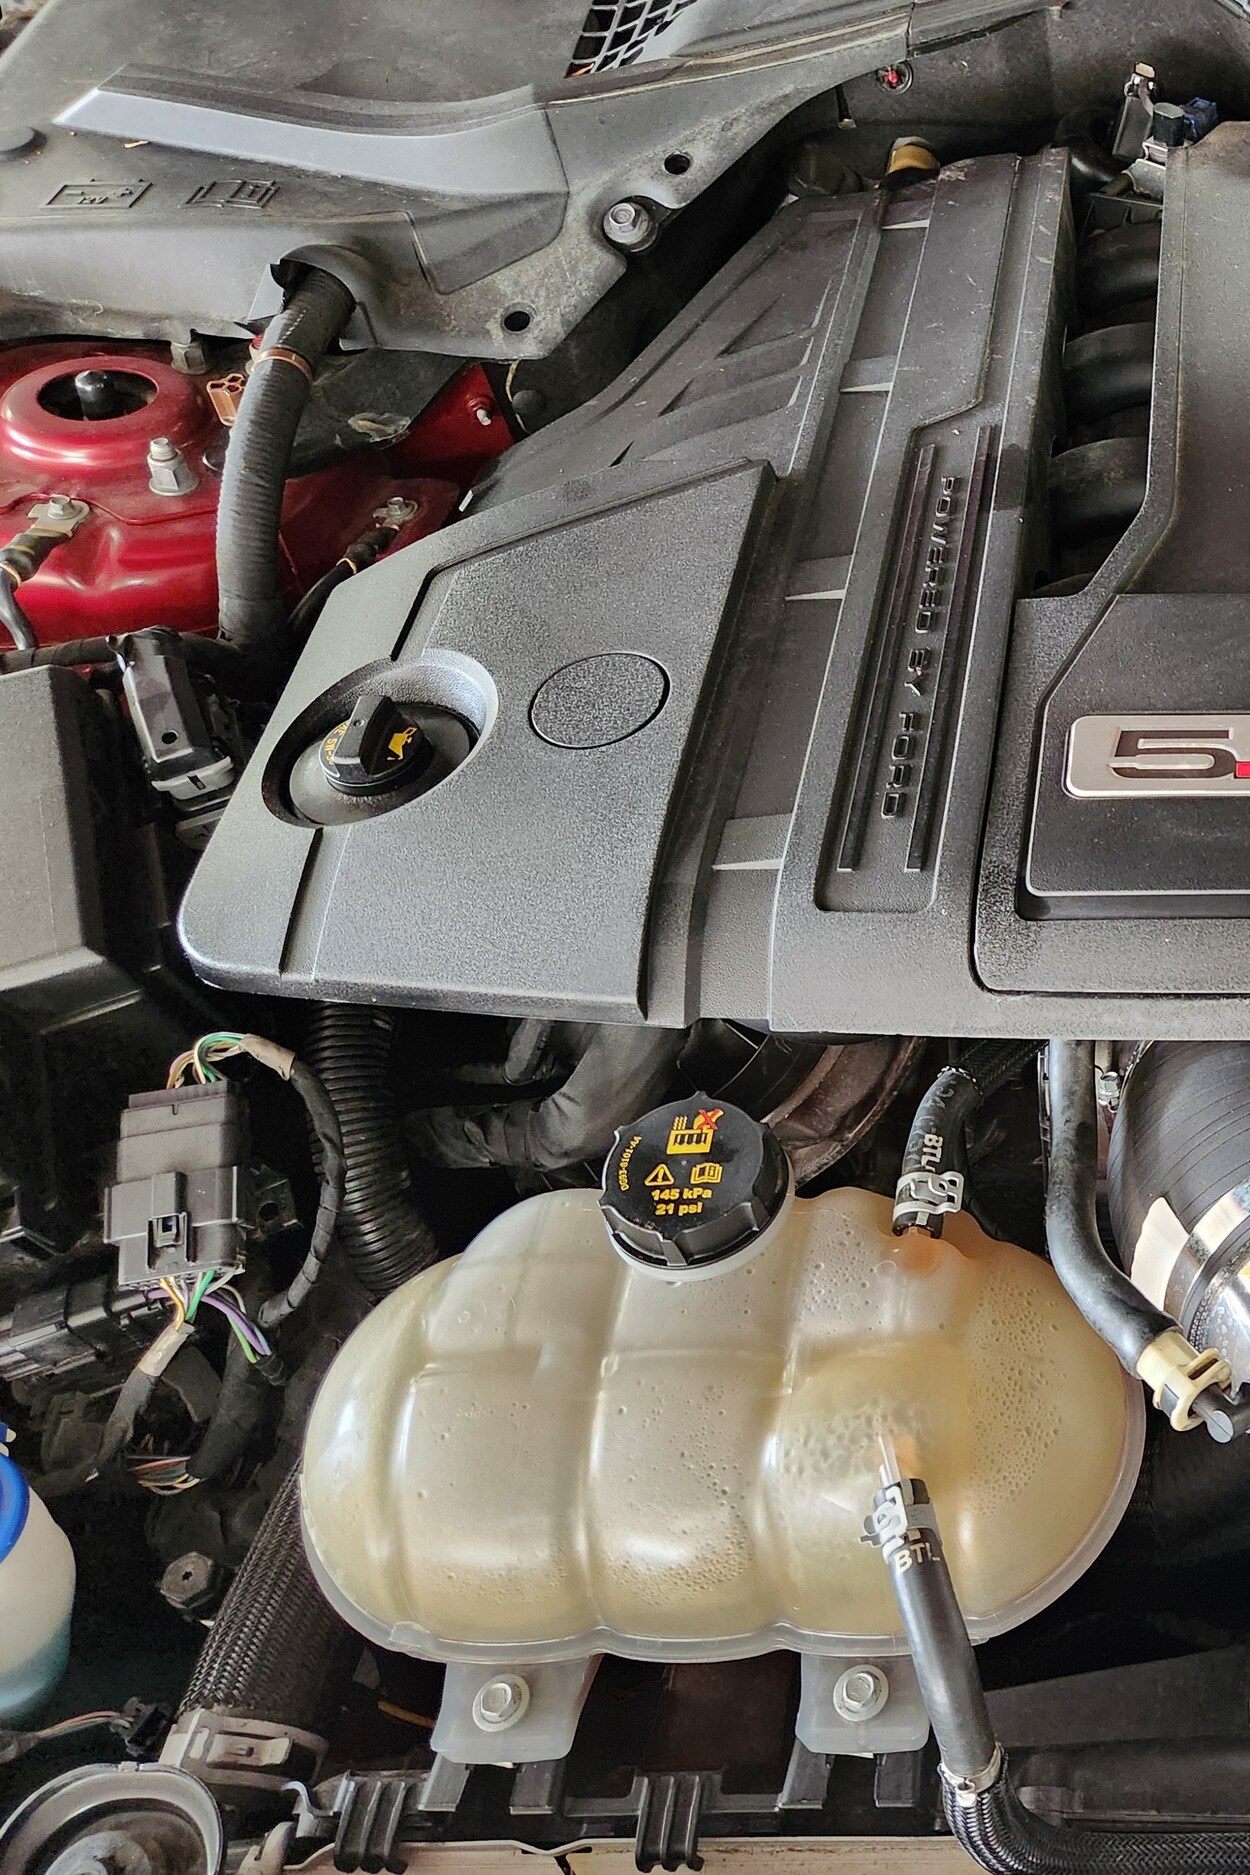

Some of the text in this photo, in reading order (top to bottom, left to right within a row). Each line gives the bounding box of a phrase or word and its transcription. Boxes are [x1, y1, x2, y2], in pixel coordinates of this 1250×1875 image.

[881, 476, 956, 819] POWERED BY FORD
[651, 1188, 713, 1201] 145 kPa
[655, 1202, 703, 1217] 21 psi
[893, 1542, 941, 1574] BTL
